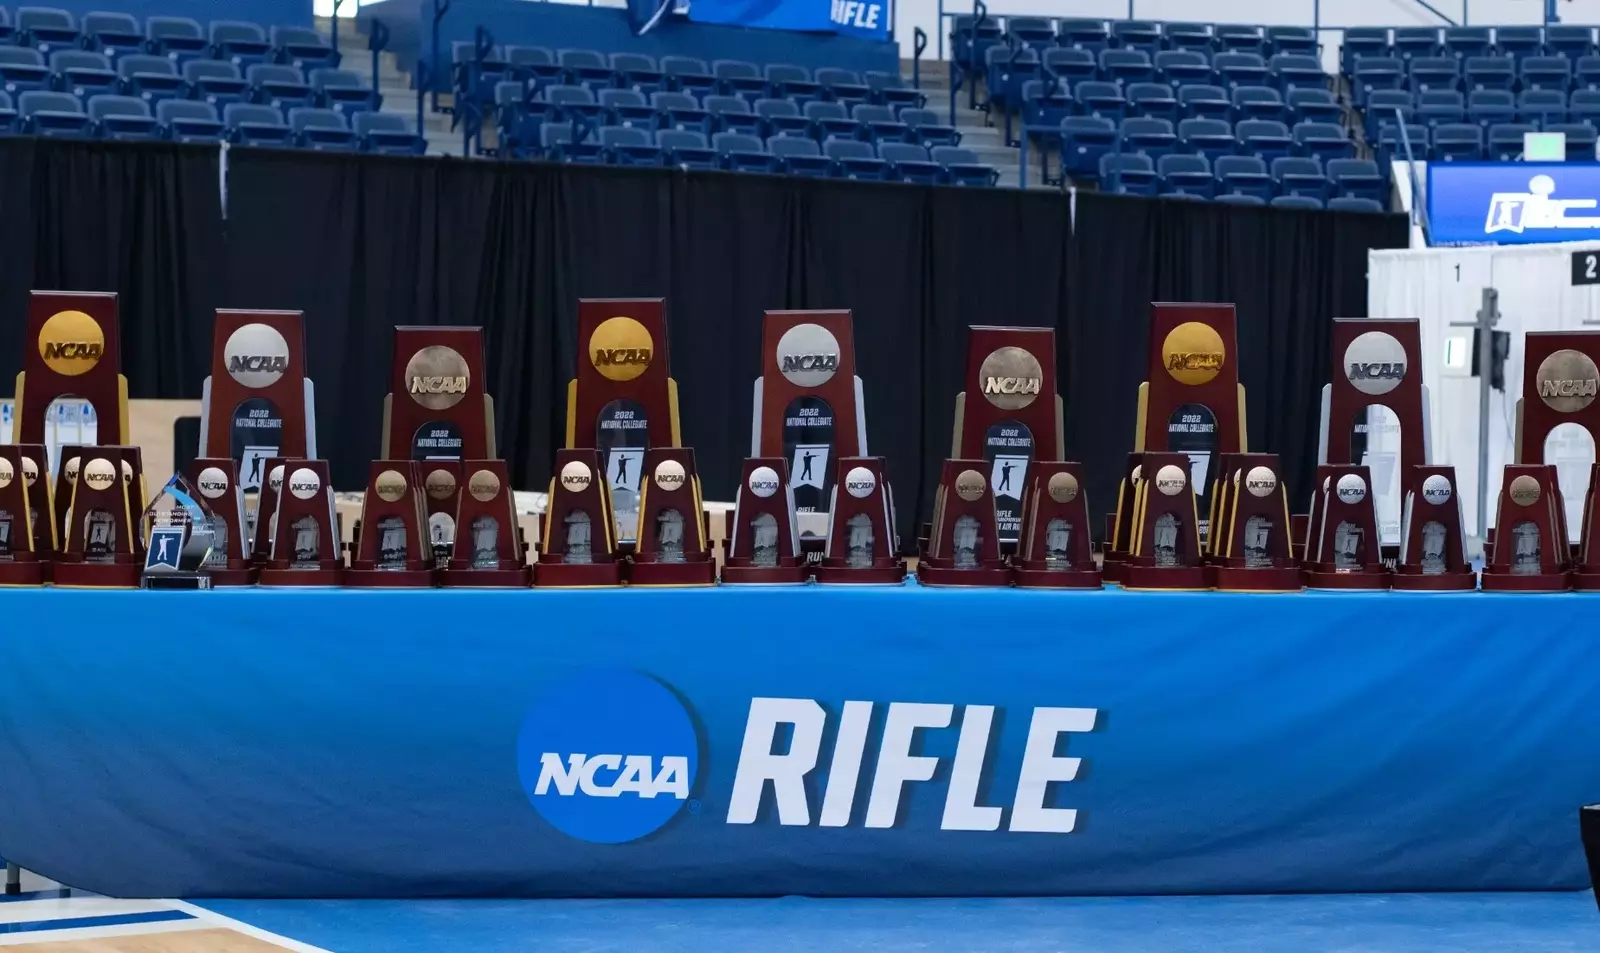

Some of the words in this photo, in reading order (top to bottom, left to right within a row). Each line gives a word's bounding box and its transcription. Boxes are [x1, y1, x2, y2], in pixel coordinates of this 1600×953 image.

[1454, 263, 1461, 282] 1
[1585, 255, 1597, 278] 2
[44, 342, 101, 360] NCAA
[594, 348, 651, 366] NCAA
[229, 355, 287, 373] NCAA
[781, 354, 837, 372] NCAA
[1168, 353, 1223, 370] NCAA
[1349, 362, 1405, 380] NCAA
[411, 376, 467, 394] NCAA
[984, 376, 1040, 394] NCAA
[1542, 379, 1598, 398] NCAA
[249, 409, 269, 418] 2022
[614, 411, 634, 419] 2022
[799, 408, 819, 416] 2022
[1182, 415, 1201, 423] 2022
[430, 430, 449, 438] 2022
[87, 473, 114, 482] NCAA
[563, 475, 591, 484] NCAA
[657, 474, 684, 483] NCAA
[201, 482, 227, 490] NCAA
[292, 483, 318, 491] NCAA
[751, 481, 778, 489] NCAA
[848, 481, 874, 489] NCAA
[1339, 488, 1365, 496] NCAA
[726, 696, 1098, 834] RIFLE
[534, 752, 689, 800] NCAA
